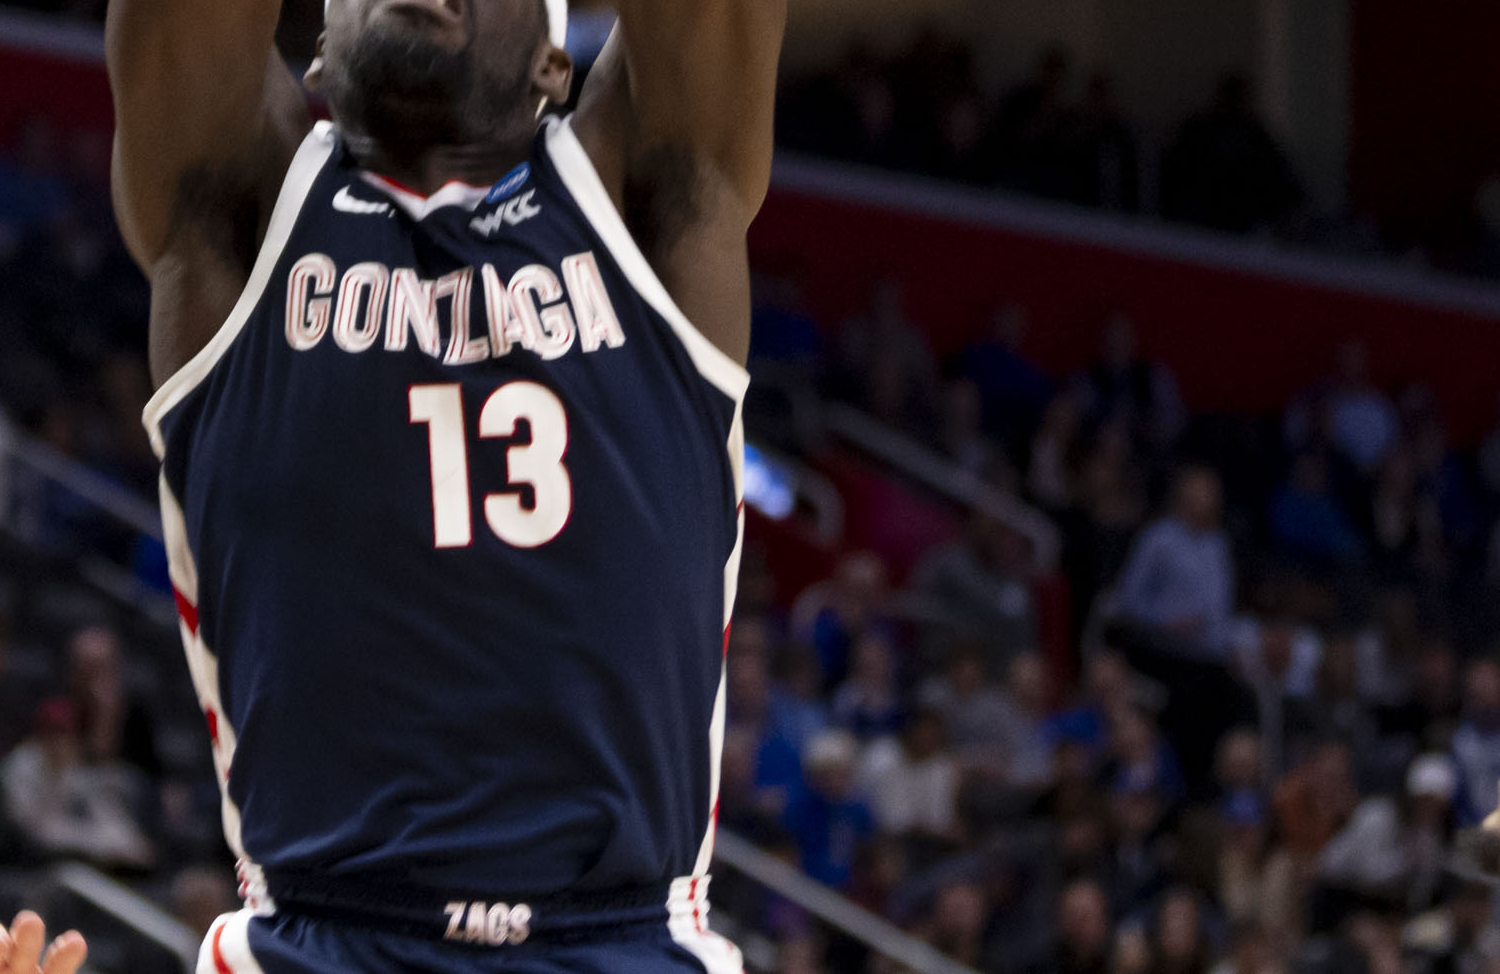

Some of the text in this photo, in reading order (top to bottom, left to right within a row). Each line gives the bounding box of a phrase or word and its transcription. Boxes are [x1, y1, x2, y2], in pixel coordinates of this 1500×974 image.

[468, 188, 542, 238] WCC
[285, 251, 626, 366] GONZAGA
[407, 380, 573, 548] 13
[443, 900, 532, 946] ZAGS
